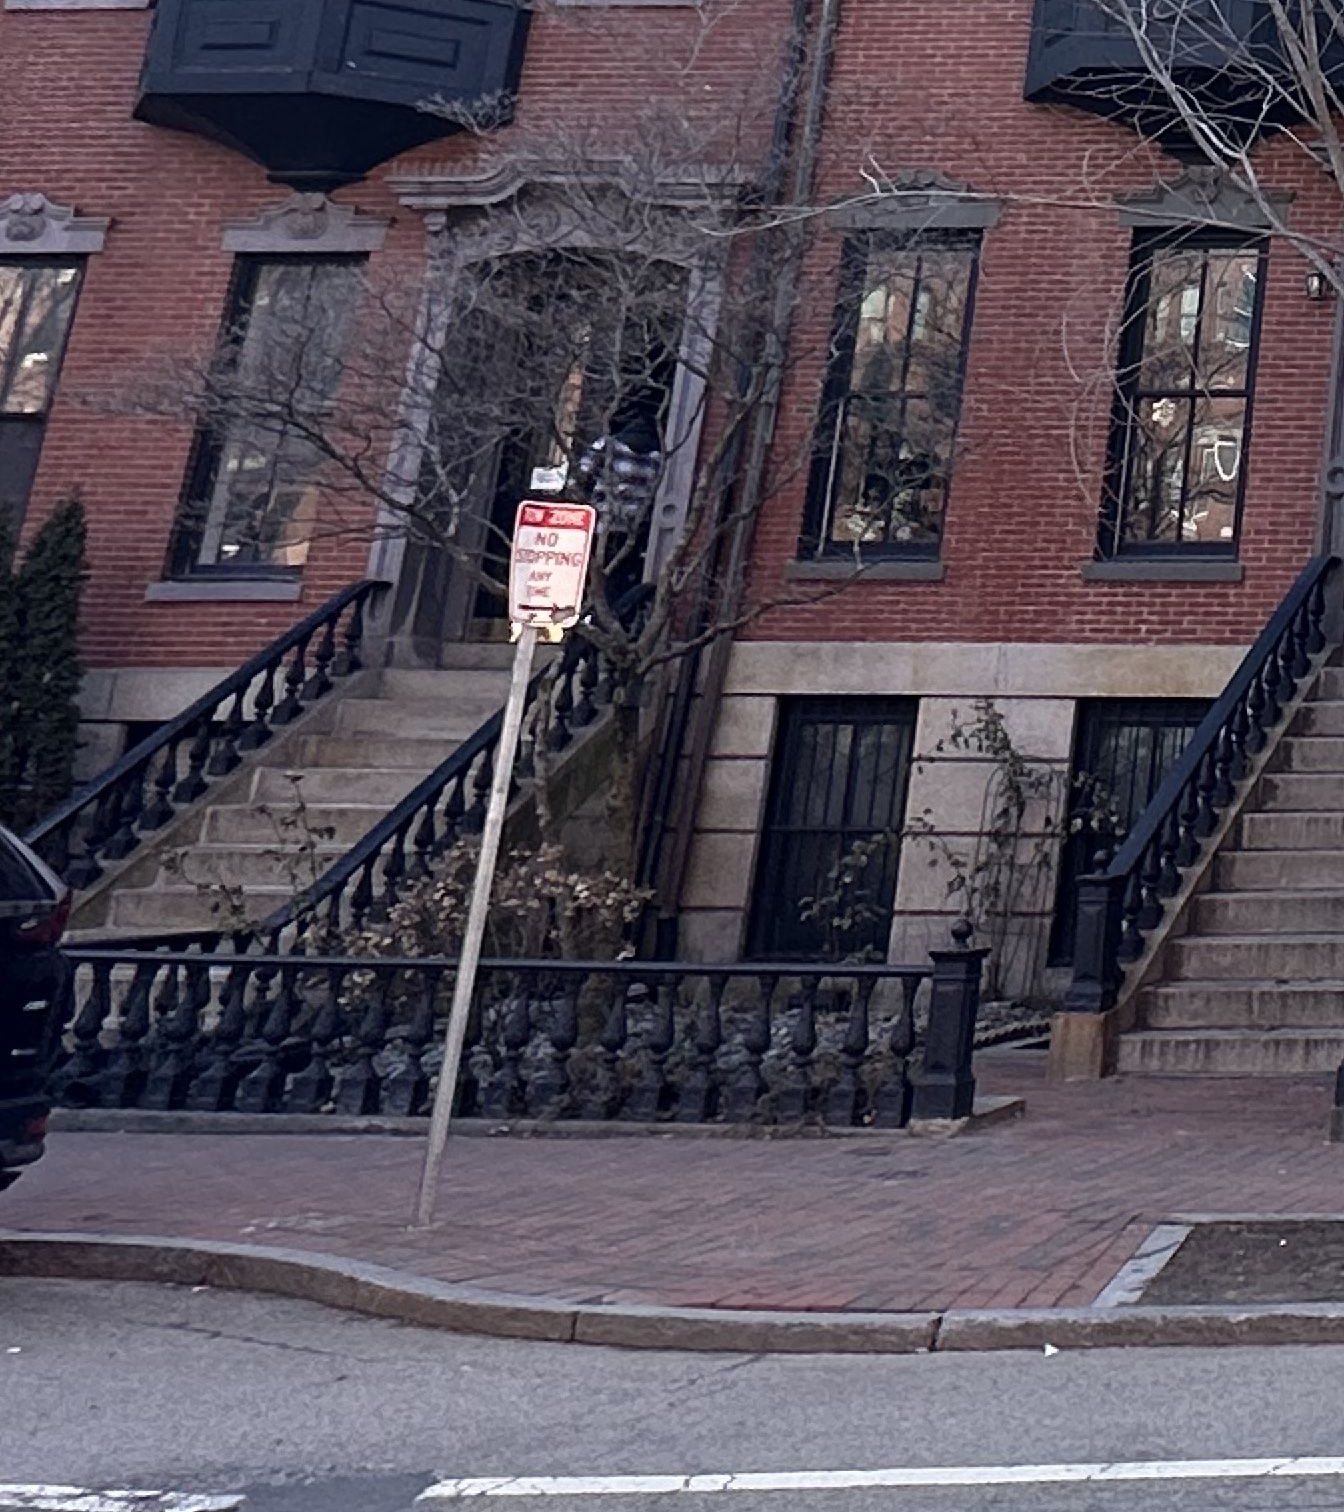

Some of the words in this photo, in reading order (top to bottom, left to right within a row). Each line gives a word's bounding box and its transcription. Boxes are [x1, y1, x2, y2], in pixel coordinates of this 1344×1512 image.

[535, 532, 559, 547] NO
[515, 548, 583, 567] STOPPING
[528, 570, 553, 581] ANY
